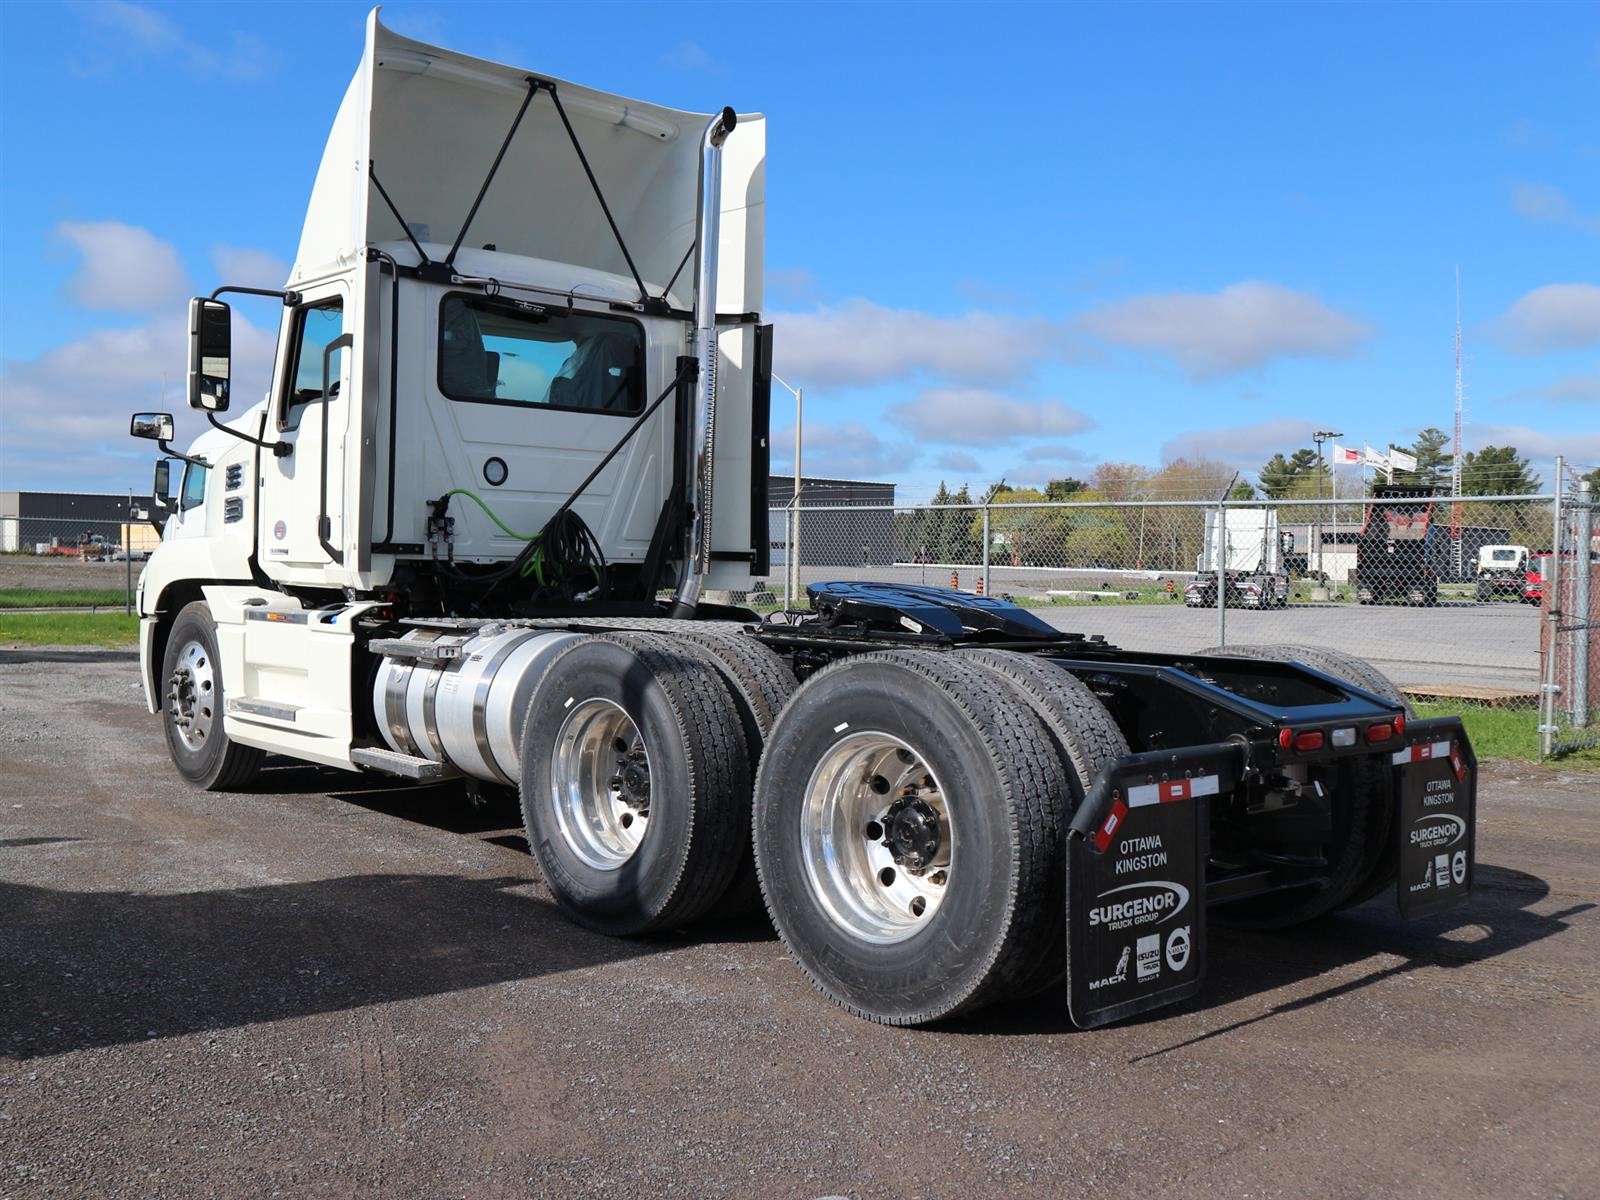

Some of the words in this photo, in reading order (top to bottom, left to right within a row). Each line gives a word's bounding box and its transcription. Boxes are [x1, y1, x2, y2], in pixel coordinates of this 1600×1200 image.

[1427, 780, 1451, 792] OTTAWA
[1424, 793, 1454, 806] KINGSTON
[1410, 823, 1457, 843] SURGENOR
[1120, 835, 1162, 854] OTTAWA
[1115, 852, 1167, 875] KINGSTON
[1410, 881, 1431, 892] MACK
[1089, 892, 1175, 926] SURGENOR
[1108, 918, 1133, 931] TRUCK
[1134, 912, 1159, 925] GROUP
[1137, 949, 1160, 961] ISUZU
[1089, 973, 1127, 990] MACK
